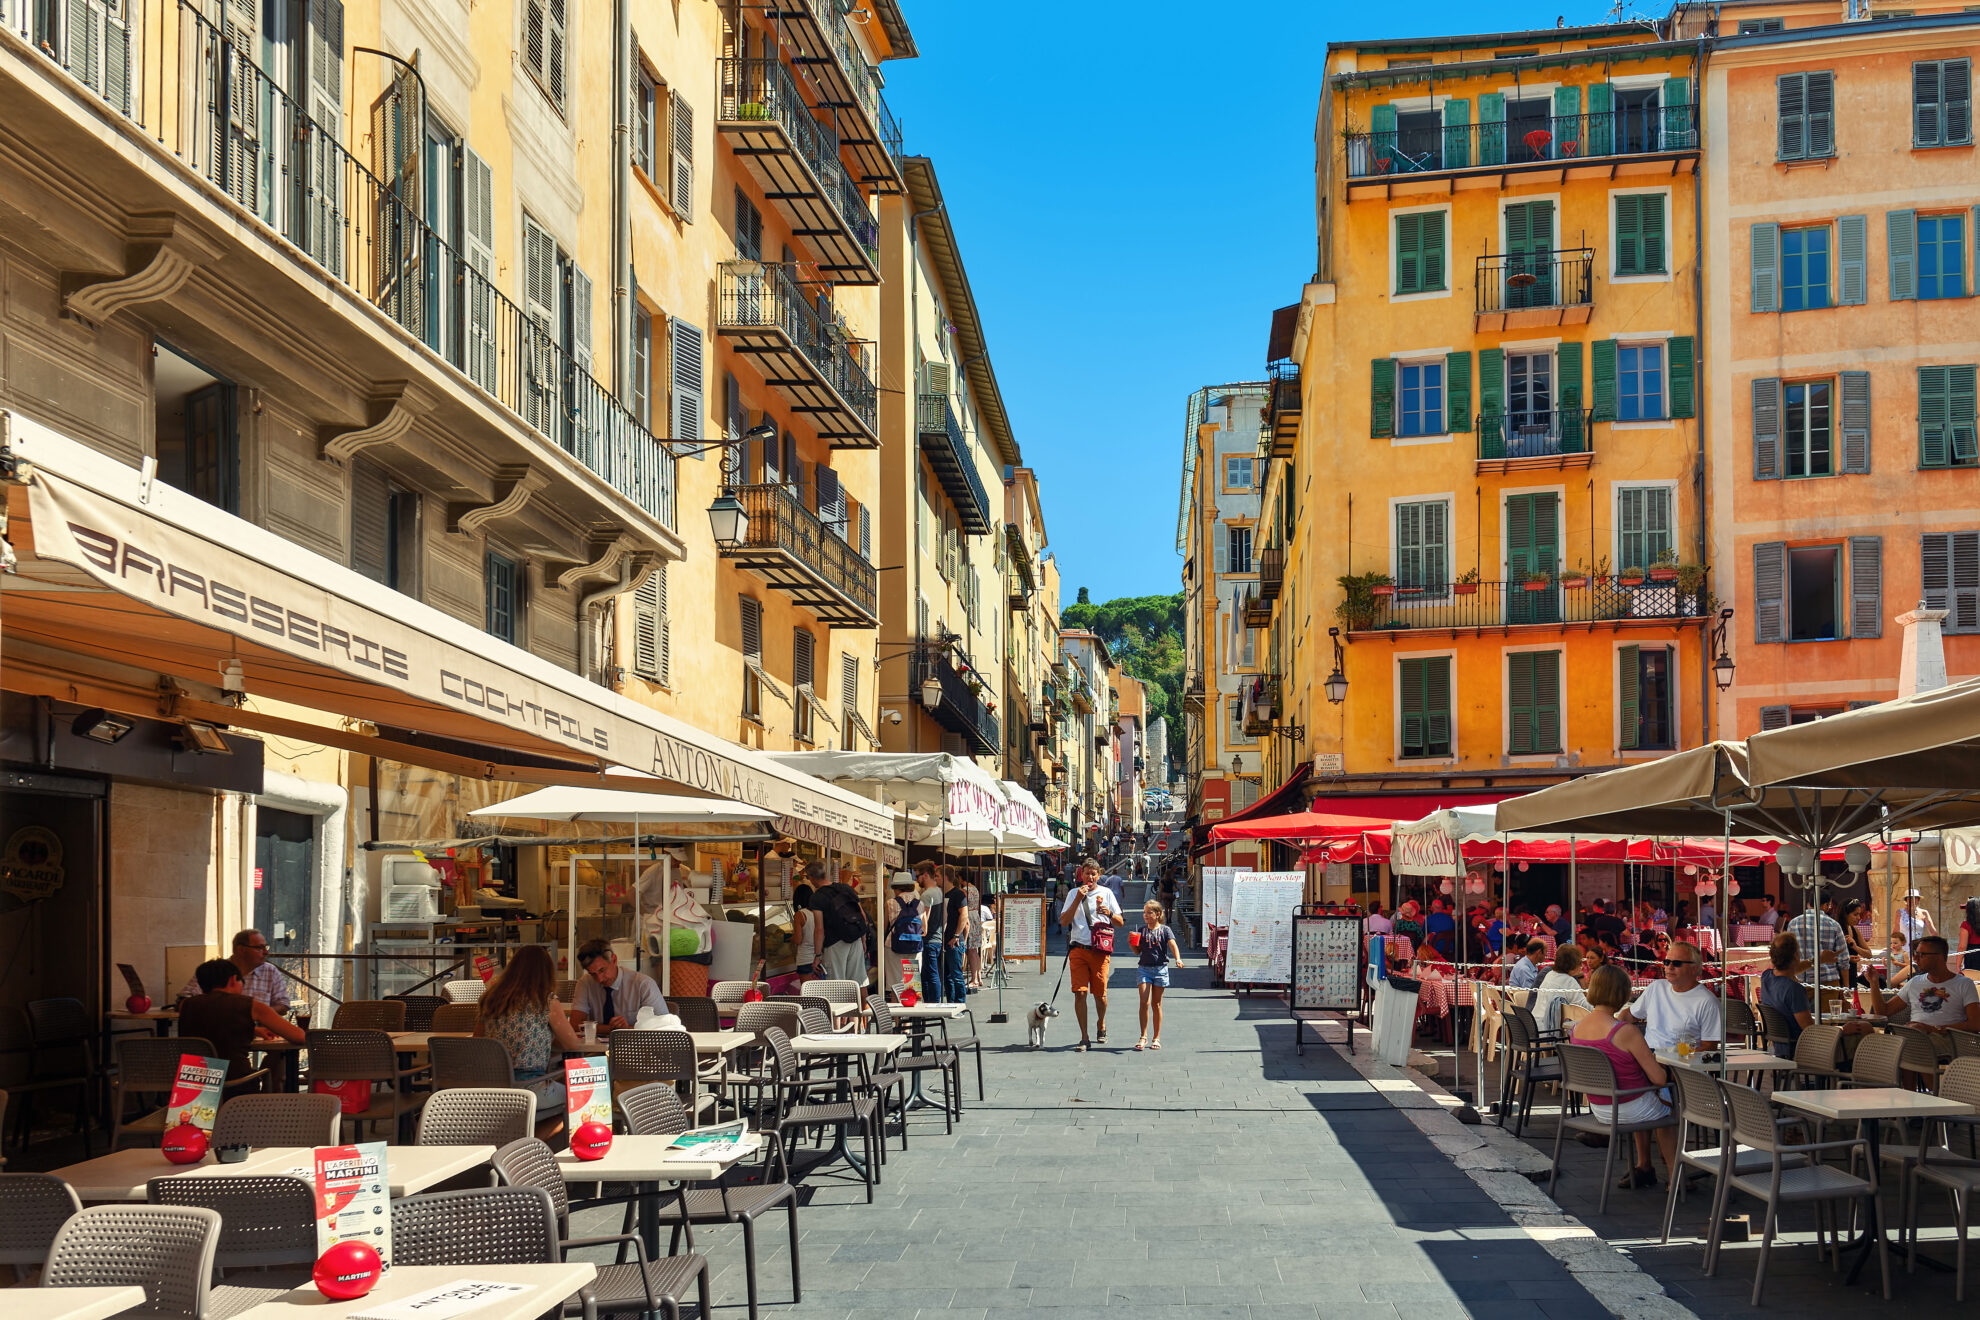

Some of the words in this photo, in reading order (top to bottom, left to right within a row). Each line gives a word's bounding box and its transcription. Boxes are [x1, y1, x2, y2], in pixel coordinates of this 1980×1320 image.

[66, 521, 409, 681] BRASSERIE
[440, 669, 609, 751] COCKTAILS
[791, 797, 849, 829] GELATERIA
[853, 818, 892, 841] CREPERIE
[182, 1066, 223, 1077] L'APERITIVO
[180, 1073, 220, 1084] MARTINI
[570, 1075, 606, 1085] MARTINI
[326, 1157, 377, 1170] L'APERITIVO
[326, 1166, 378, 1180] MARTINI
[337, 1271, 371, 1282] MARTINI
[410, 1284, 483, 1309] ANTONIA
